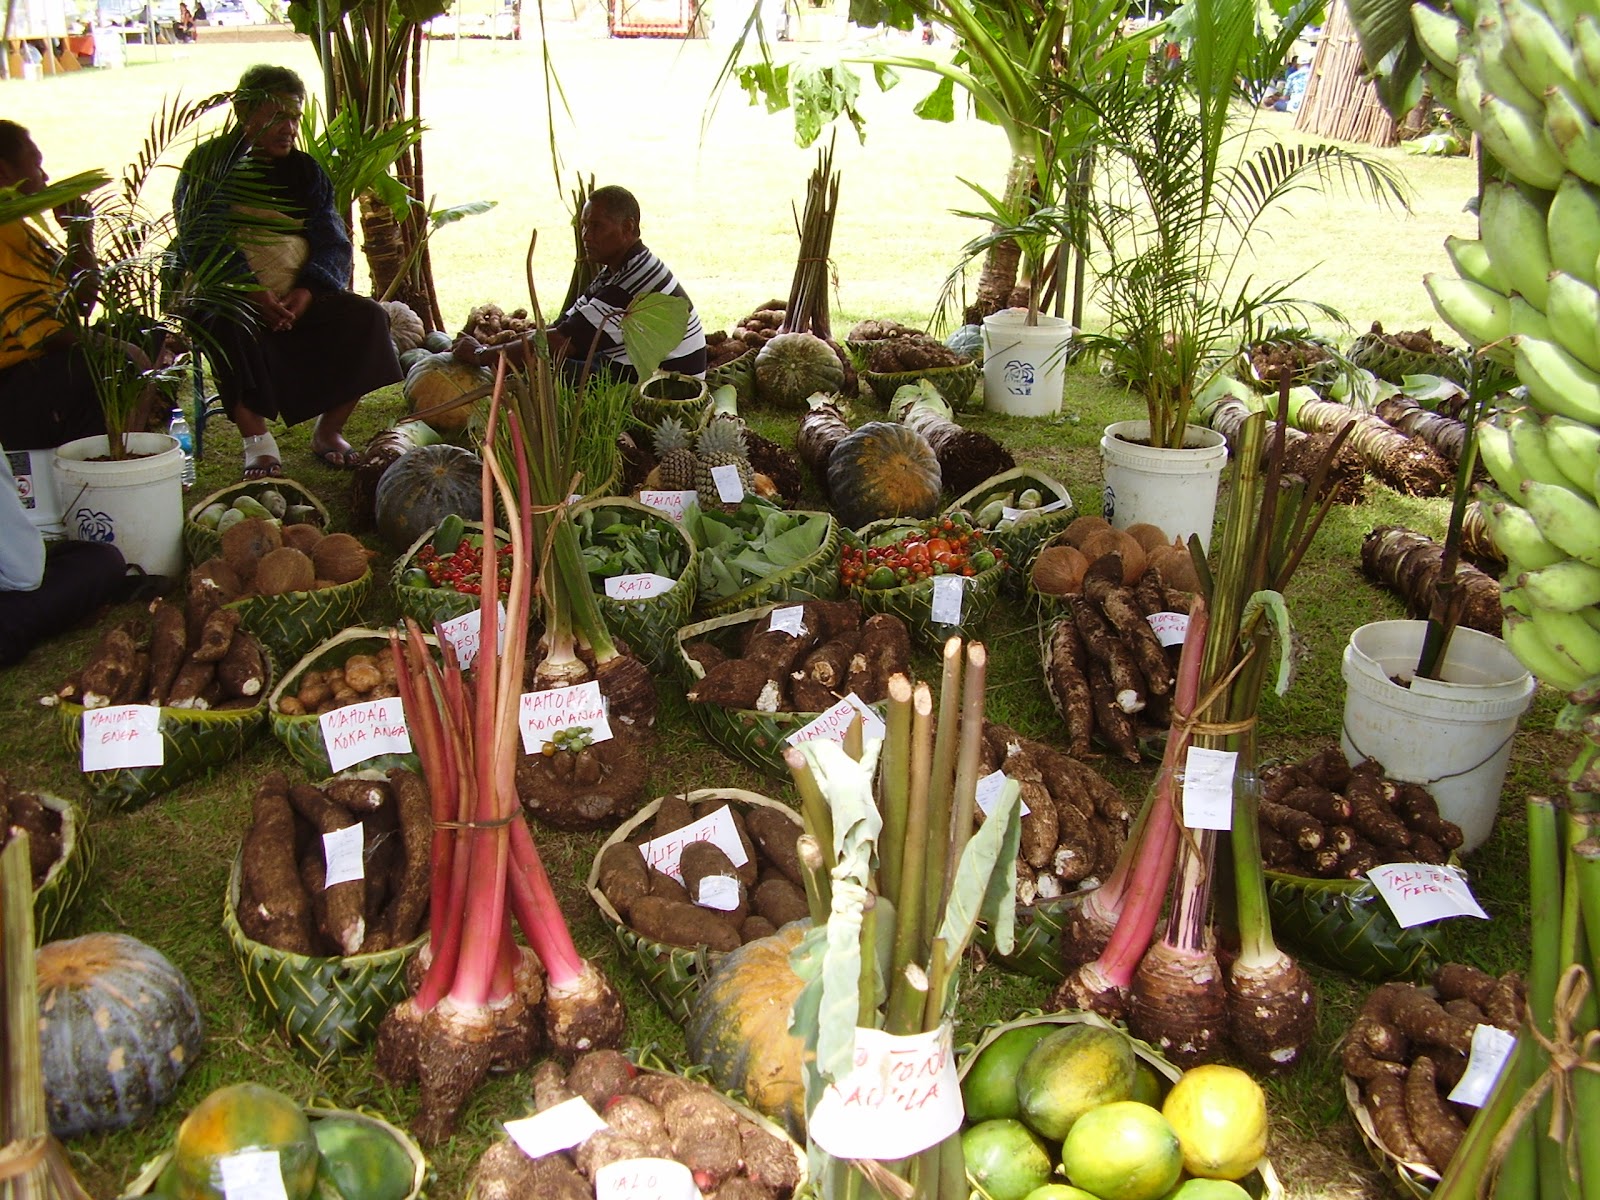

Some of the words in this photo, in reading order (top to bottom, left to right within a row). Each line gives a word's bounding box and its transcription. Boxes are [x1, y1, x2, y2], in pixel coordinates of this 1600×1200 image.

[616, 577, 652, 595] KATO
[91, 709, 138, 727] MANIOKE
[101, 729, 139, 744] ENGA
